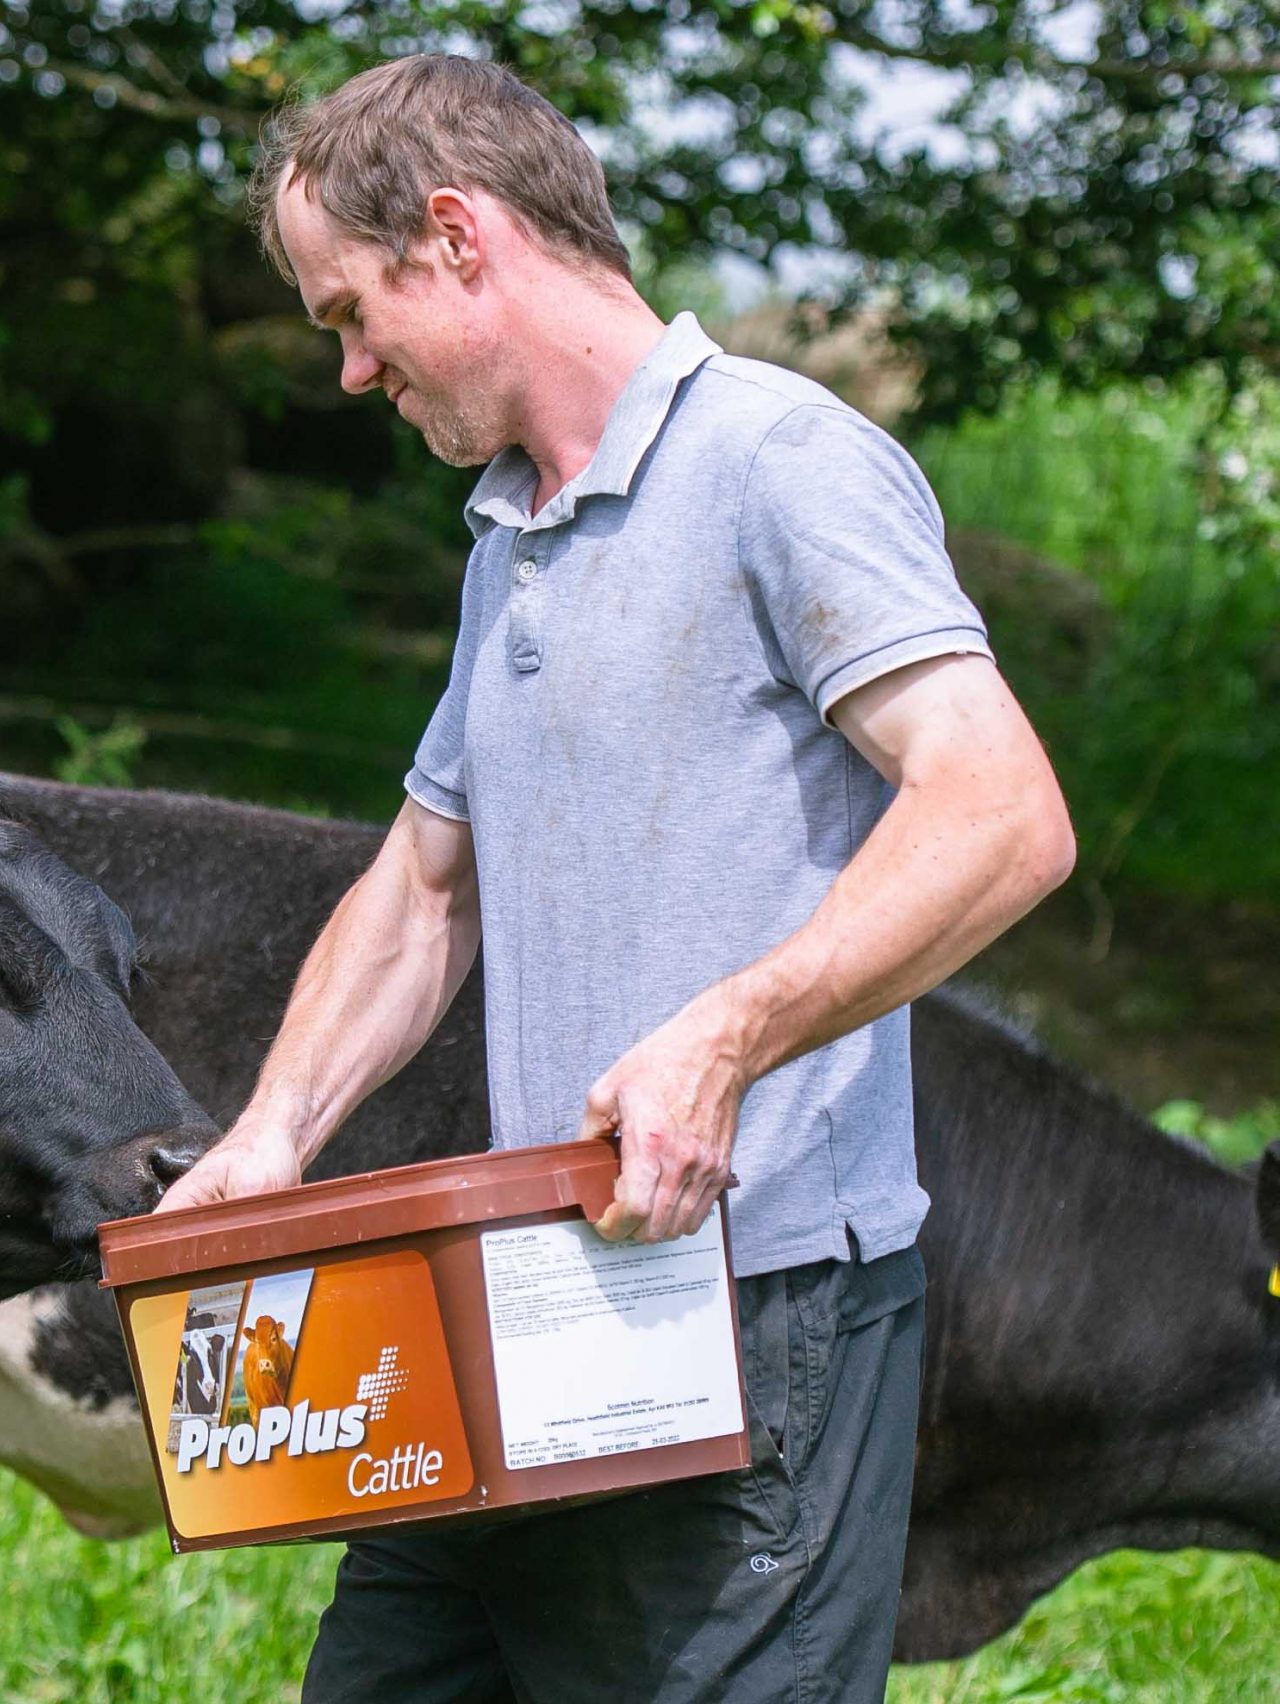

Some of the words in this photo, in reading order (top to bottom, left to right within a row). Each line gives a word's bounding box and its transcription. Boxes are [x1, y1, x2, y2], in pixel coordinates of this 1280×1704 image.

[486, 1238, 516, 1246] ProPlus
[517, 1235, 537, 1243] Cattle
[177, 1399, 368, 1473] ProPlus
[598, 1445, 614, 1454] BEST
[510, 1457, 535, 1466] BATCH
[348, 1442, 443, 1498] Cattle
